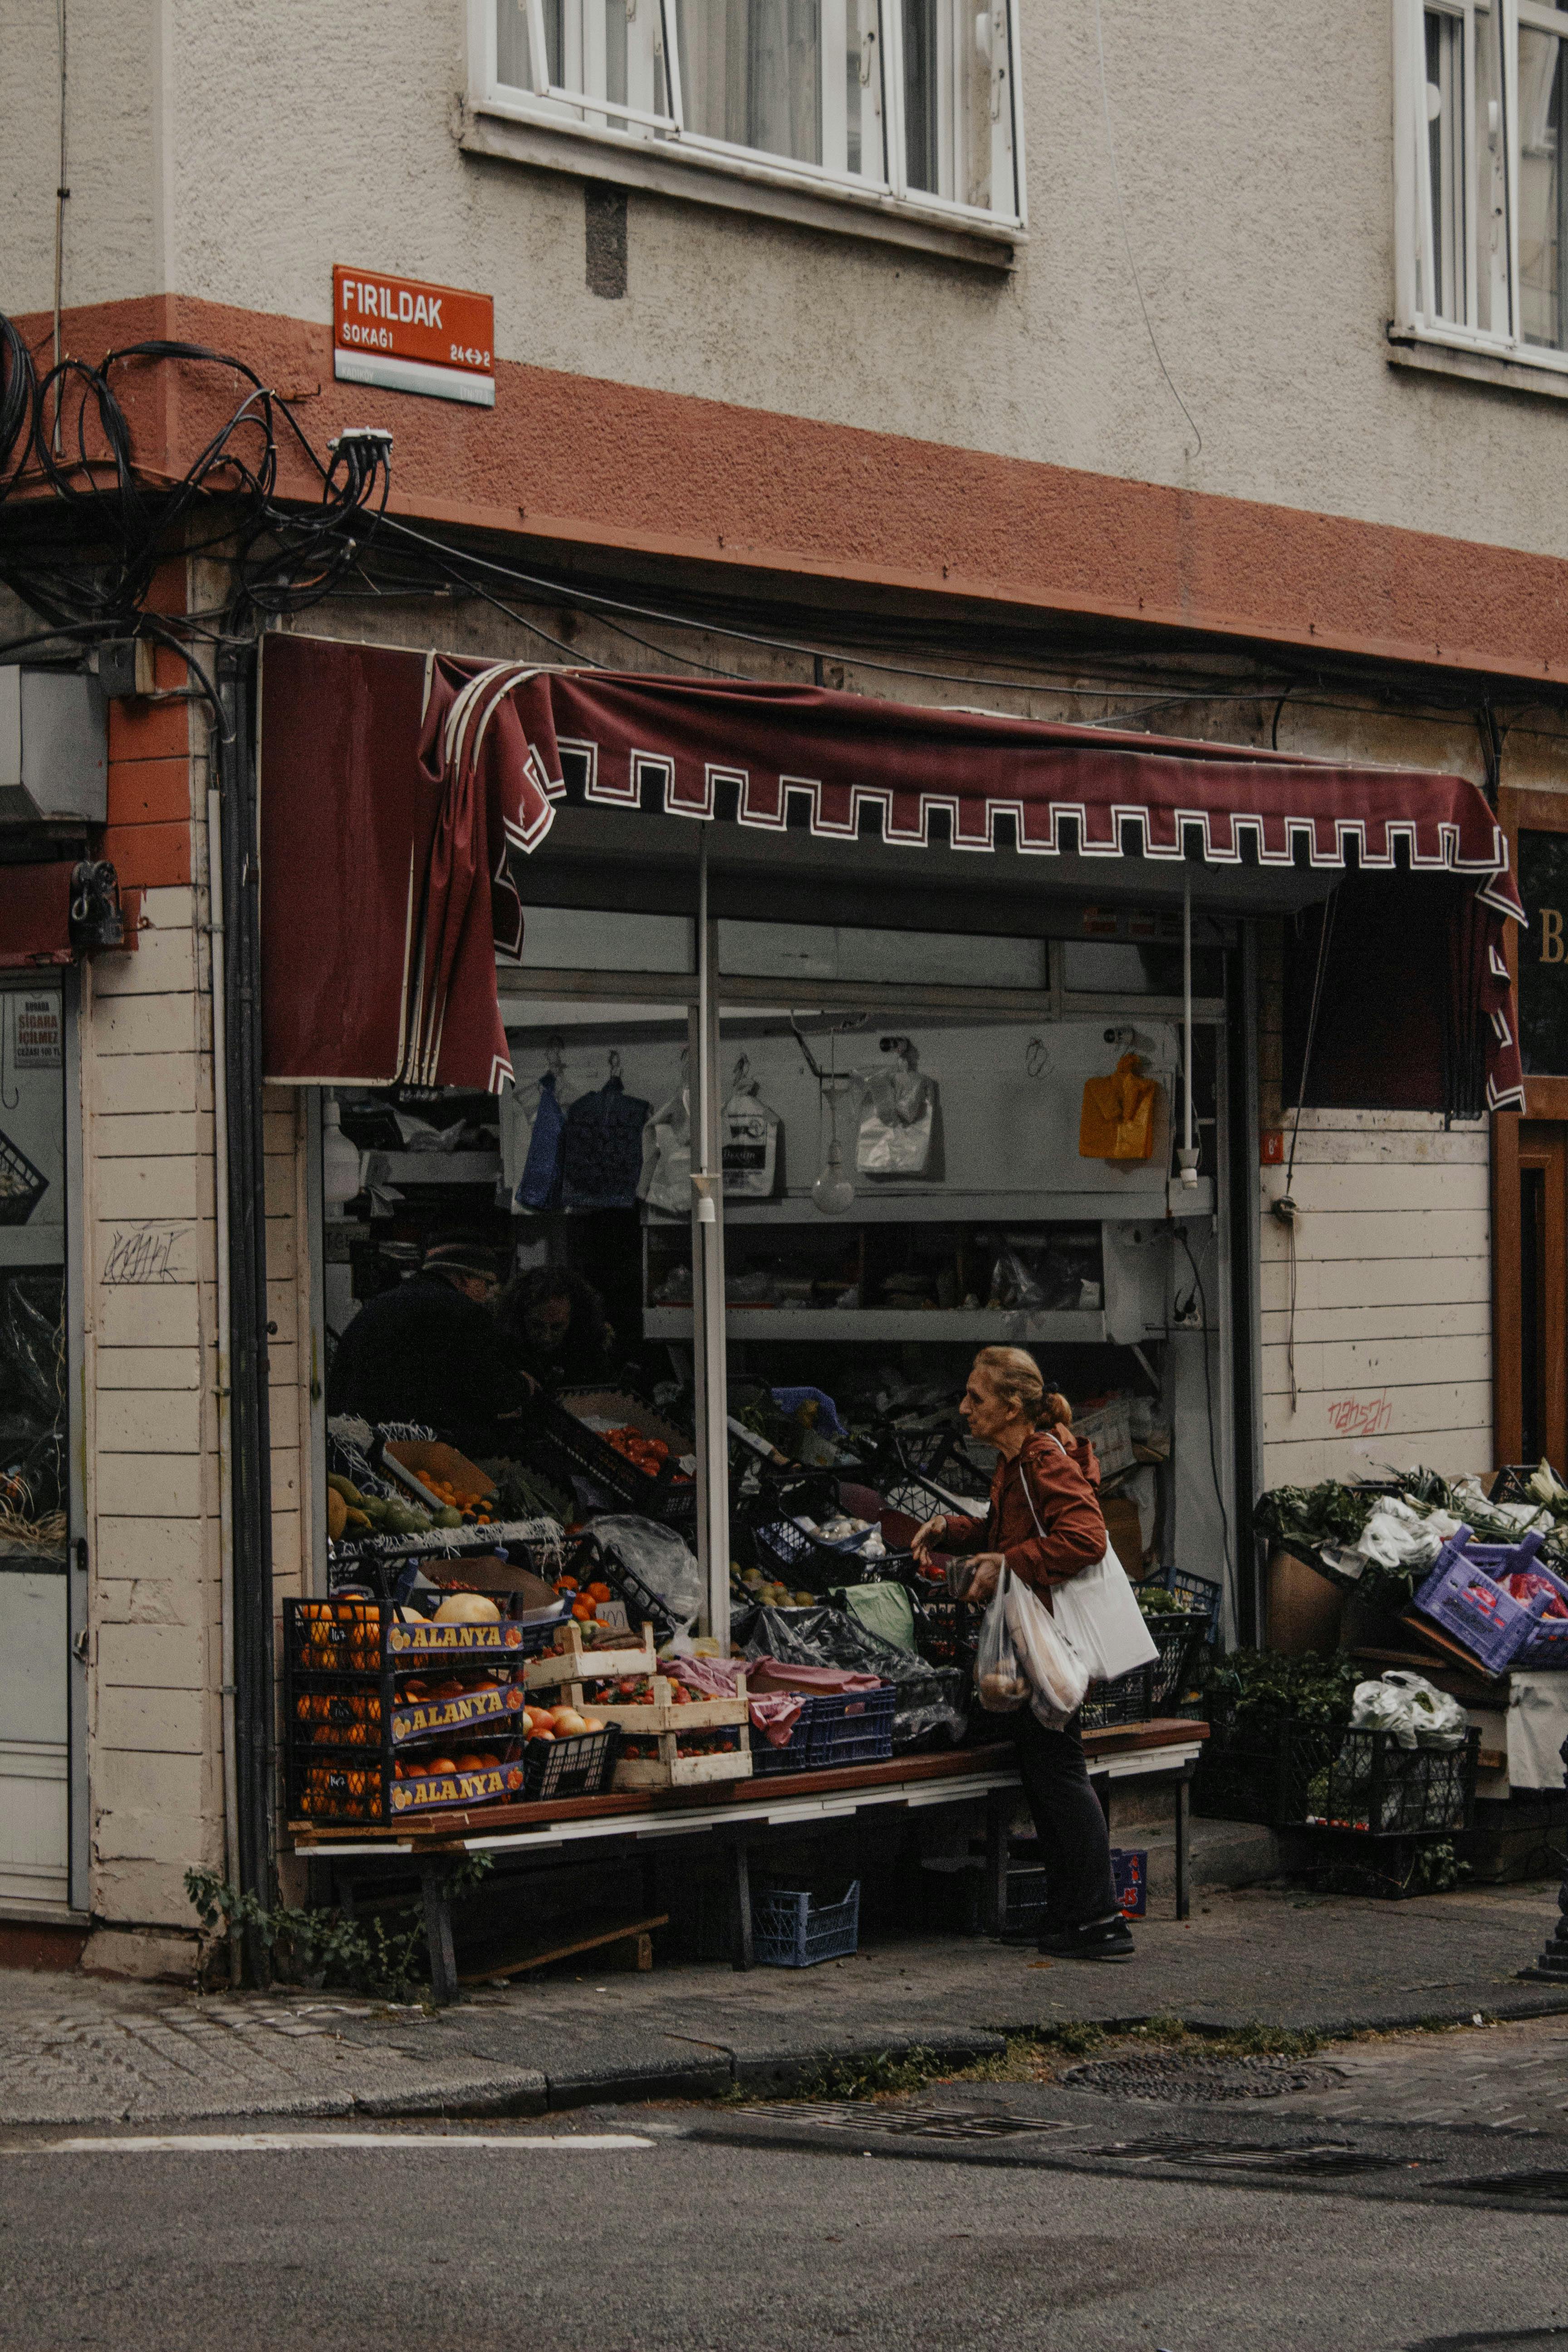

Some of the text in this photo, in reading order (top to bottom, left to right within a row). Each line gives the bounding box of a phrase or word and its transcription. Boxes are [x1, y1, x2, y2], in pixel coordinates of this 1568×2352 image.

[343, 279, 442, 329] FIRILDAK
[343, 323, 393, 348] SOKAĞI
[19, 1014, 58, 1029] SİGARA
[412, 1626, 501, 1647] ALANYA
[412, 1691, 504, 1731] ALANYA
[414, 1771, 505, 1804] ALANYA
